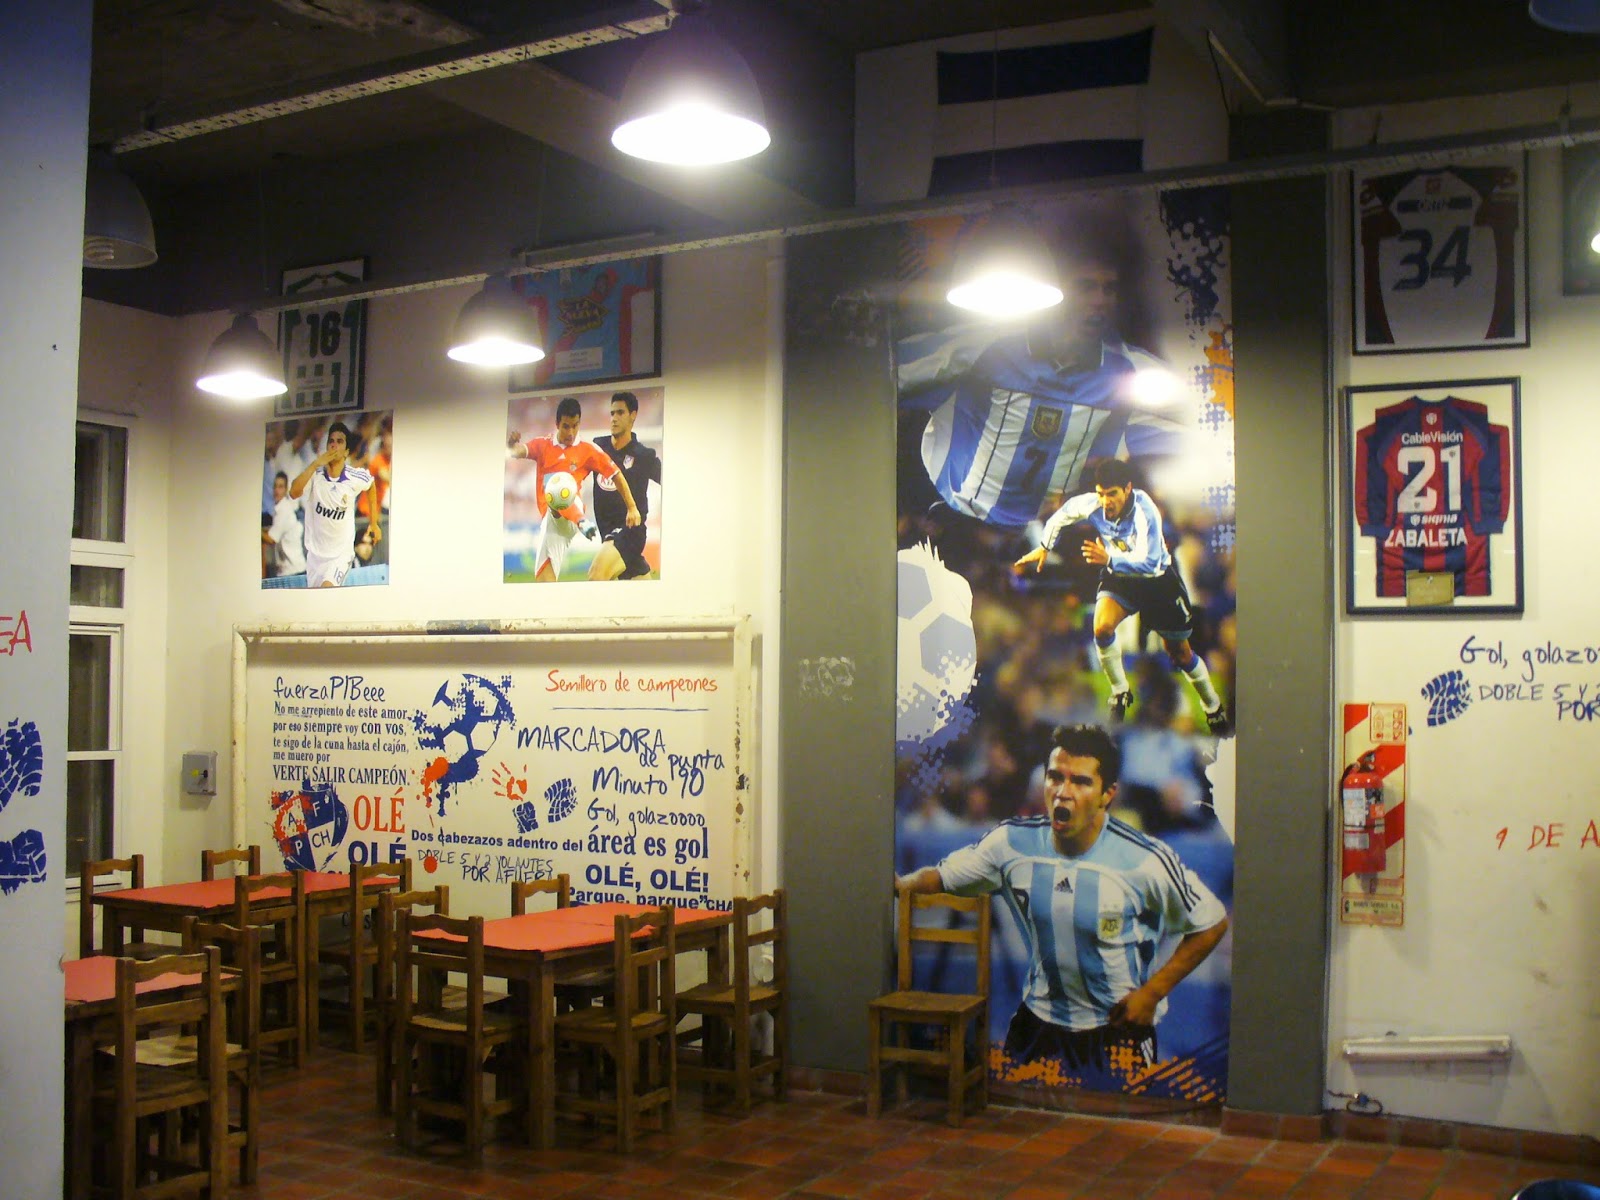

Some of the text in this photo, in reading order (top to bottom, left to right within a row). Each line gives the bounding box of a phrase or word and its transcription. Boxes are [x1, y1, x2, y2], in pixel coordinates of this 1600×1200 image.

[1392, 226, 1472, 291] 34
[1401, 431, 1464, 445] CableVisión
[1397, 445, 1461, 513] 21
[315, 501, 347, 521] bwin
[1460, 635, 1600, 683] Gol, golazo
[545, 669, 718, 703] Semillero de campeones
[1478, 683, 1544, 701] DOBLE
[1552, 684, 1571, 699] 5
[1579, 684, 1588, 700] Y
[274, 701, 286, 715] No
[287, 706, 300, 715] me
[301, 703, 343, 718] arrepiento
[345, 705, 356, 718] de
[358, 706, 379, 718] este
[273, 722, 407, 736] por eso siempre voy con vos,
[273, 737, 282, 748] te
[283, 735, 299, 750] sigo
[301, 736, 312, 749] de
[314, 736, 322, 749] la
[324, 739, 344, 750] cuna
[347, 737, 370, 751] hasta
[373, 738, 380, 751] el
[517, 724, 666, 754] MARCADORA
[273, 751, 330, 764] me muero por
[639, 749, 725, 781] de punta
[273, 764, 411, 786] VERTE SALIR CAMPEÓN.
[592, 766, 668, 796] Minuto
[353, 787, 406, 834] OLÉ
[587, 797, 620, 826] Gol,
[411, 824, 709, 865] Dos cabezazos adentro del área es gol
[1527, 823, 1564, 851] DE
[418, 849, 455, 864] DOBLE
[460, 853, 470, 865] 5
[484, 855, 492, 868] 2
[462, 865, 490, 883] POR
[585, 862, 709, 893] OLÉ, OLÉ!
